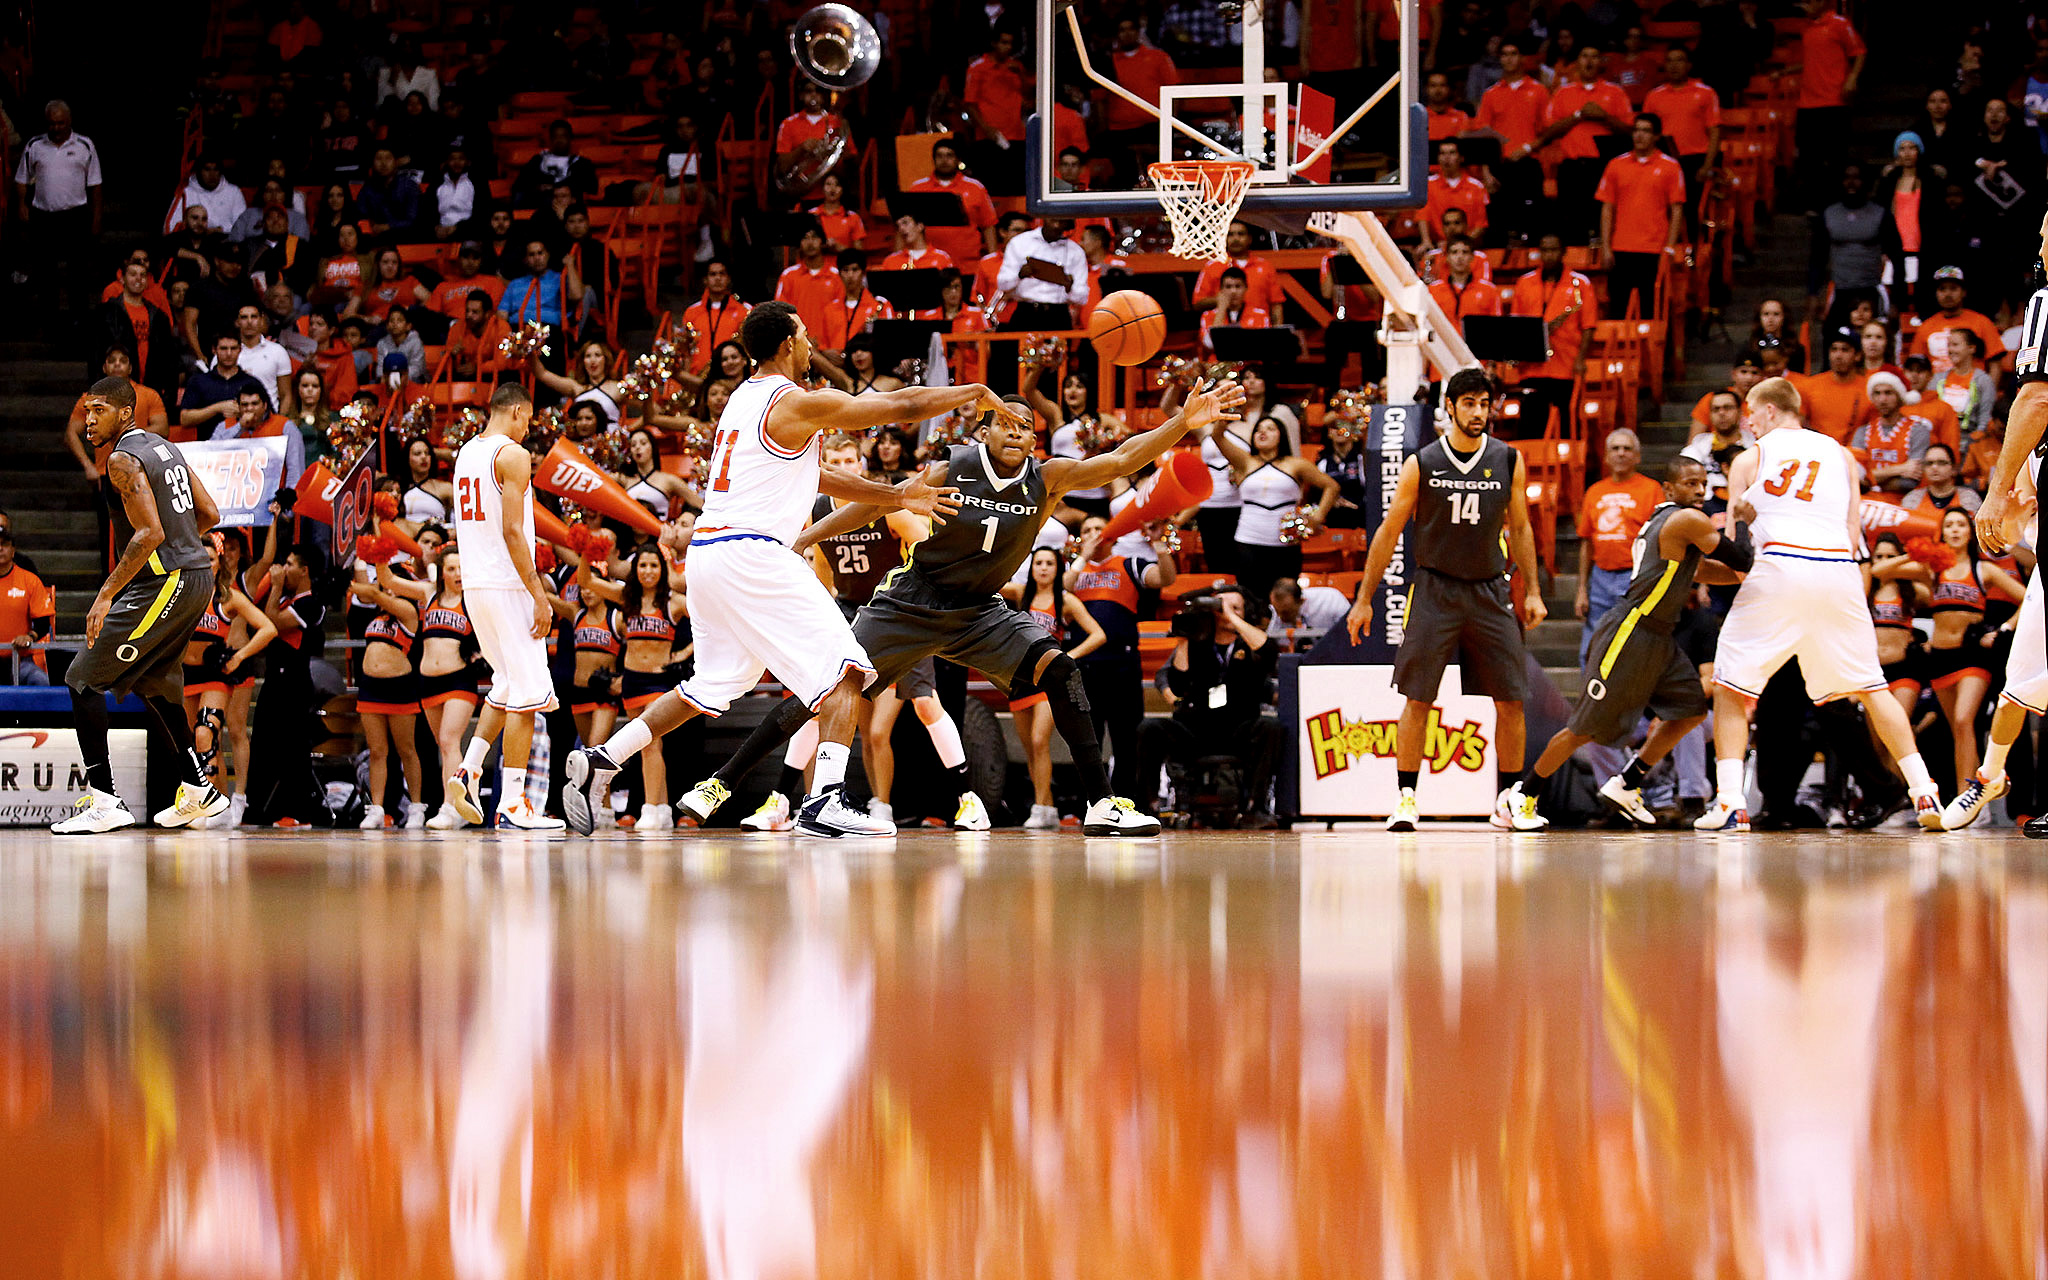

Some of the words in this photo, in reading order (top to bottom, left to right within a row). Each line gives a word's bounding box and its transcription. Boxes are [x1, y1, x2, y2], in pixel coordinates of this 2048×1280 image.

[164, 464, 193, 514] 33
[550, 460, 604, 493] UTEP
[1428, 477, 1502, 490] OREGON
[1763, 458, 1821, 502] 31
[336, 466, 373, 556] GO
[458, 477, 486, 521] 21
[949, 491, 1039, 516] OREGON
[1447, 492, 1481, 525] 14
[980, 515, 1000, 554] 1
[835, 544, 870, 574] 25
[160, 580, 185, 619] DUCKS
